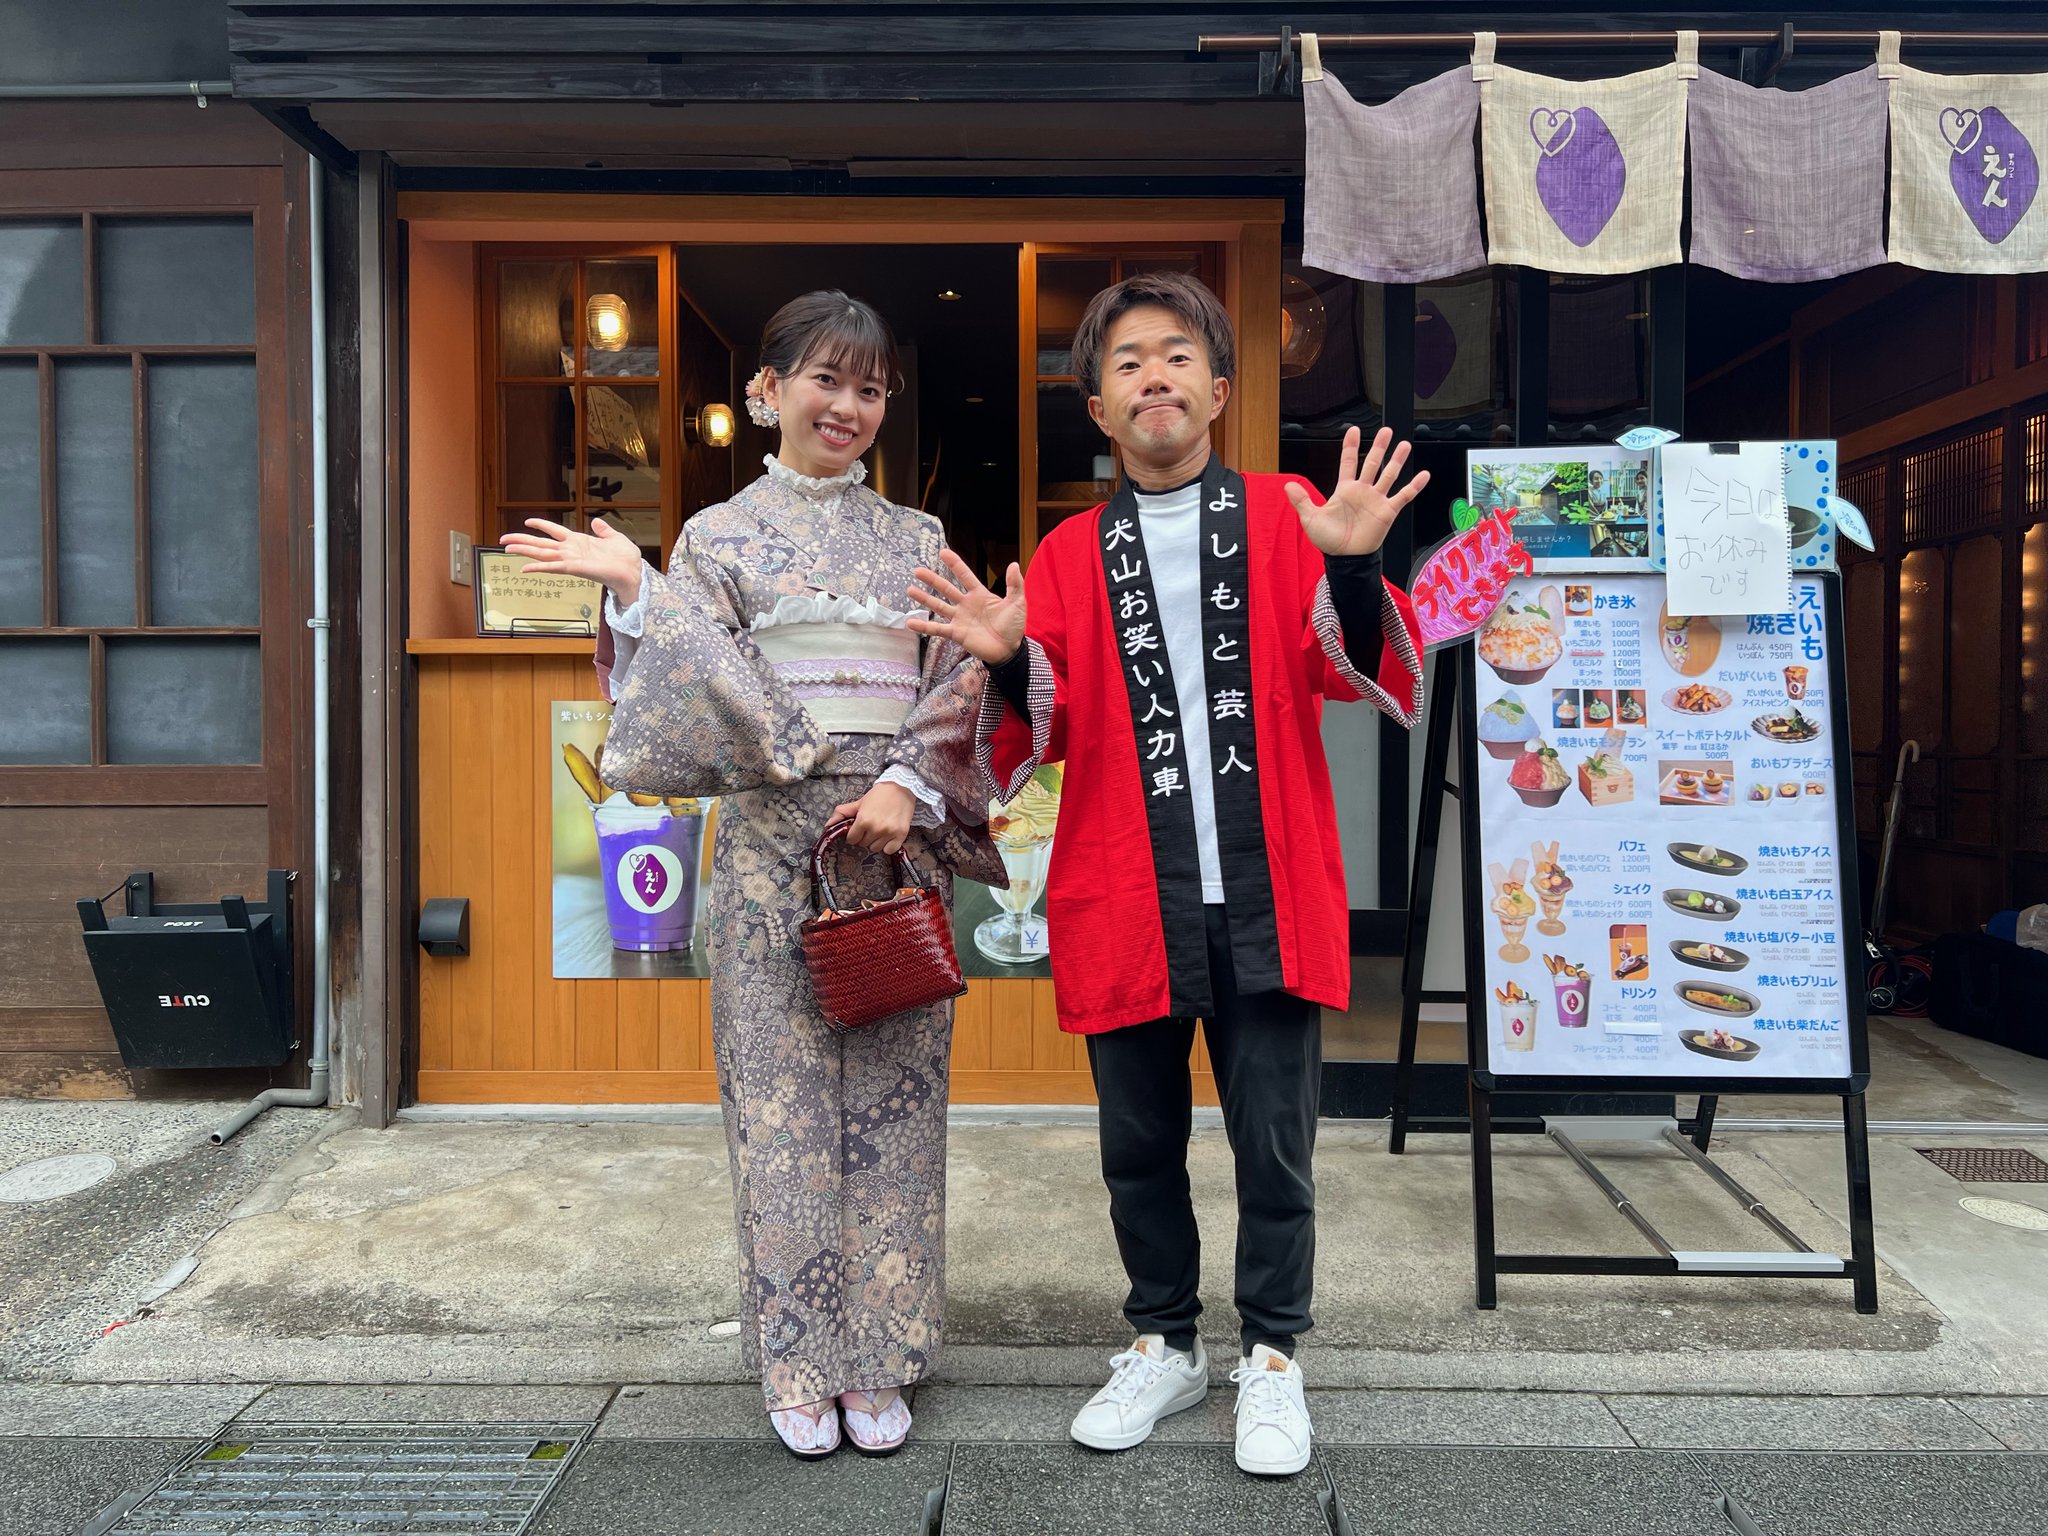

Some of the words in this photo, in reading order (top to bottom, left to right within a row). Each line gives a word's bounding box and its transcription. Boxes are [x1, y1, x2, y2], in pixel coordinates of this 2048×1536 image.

[1982, 145, 2007, 208] えん
[1685, 466, 1780, 523] 今日は
[1675, 533, 1768, 570] お休み
[490, 565, 510, 573] 本日
[1414, 506, 1519, 620] テイクアウト
[491, 576, 596, 588] テイクアウトのご注文は
[1450, 541, 1534, 622] できます
[1701, 569, 1748, 597] です
[492, 587, 562, 599] 店内で承ります
[1594, 595, 1636, 609] かき氷
[1612, 620, 1639, 628] 1000円
[1208, 487, 1252, 775] よしもと芸人
[1565, 639, 1601, 647] いちごミルク
[1105, 518, 1184, 797] 犬山お笑い人力車
[1613, 669, 1641, 677] 1000円
[1719, 671, 1777, 682] だいがくいも
[1557, 736, 1647, 748] 焼きいもモンブラン
[1624, 754, 1647, 762] 700円
[1618, 840, 1646, 851] パフェ
[1758, 846, 1831, 857] 焼きいもアイス
[1622, 854, 1650, 862] 1200円
[1623, 864, 1651, 872] 1200円
[645, 868, 656, 894] えん
[1614, 883, 1651, 894] シェイク
[1736, 888, 1834, 900] 焼きいも白玉アイス
[1628, 900, 1652, 908] 600円
[1629, 910, 1652, 918] 600円
[1724, 931, 1836, 944] 焼きいも塩バター小豆
[1757, 975, 1838, 987] 焼きいもブリュレ
[1621, 988, 1657, 999] ドリンク
[158, 995, 210, 1007] CUTE
